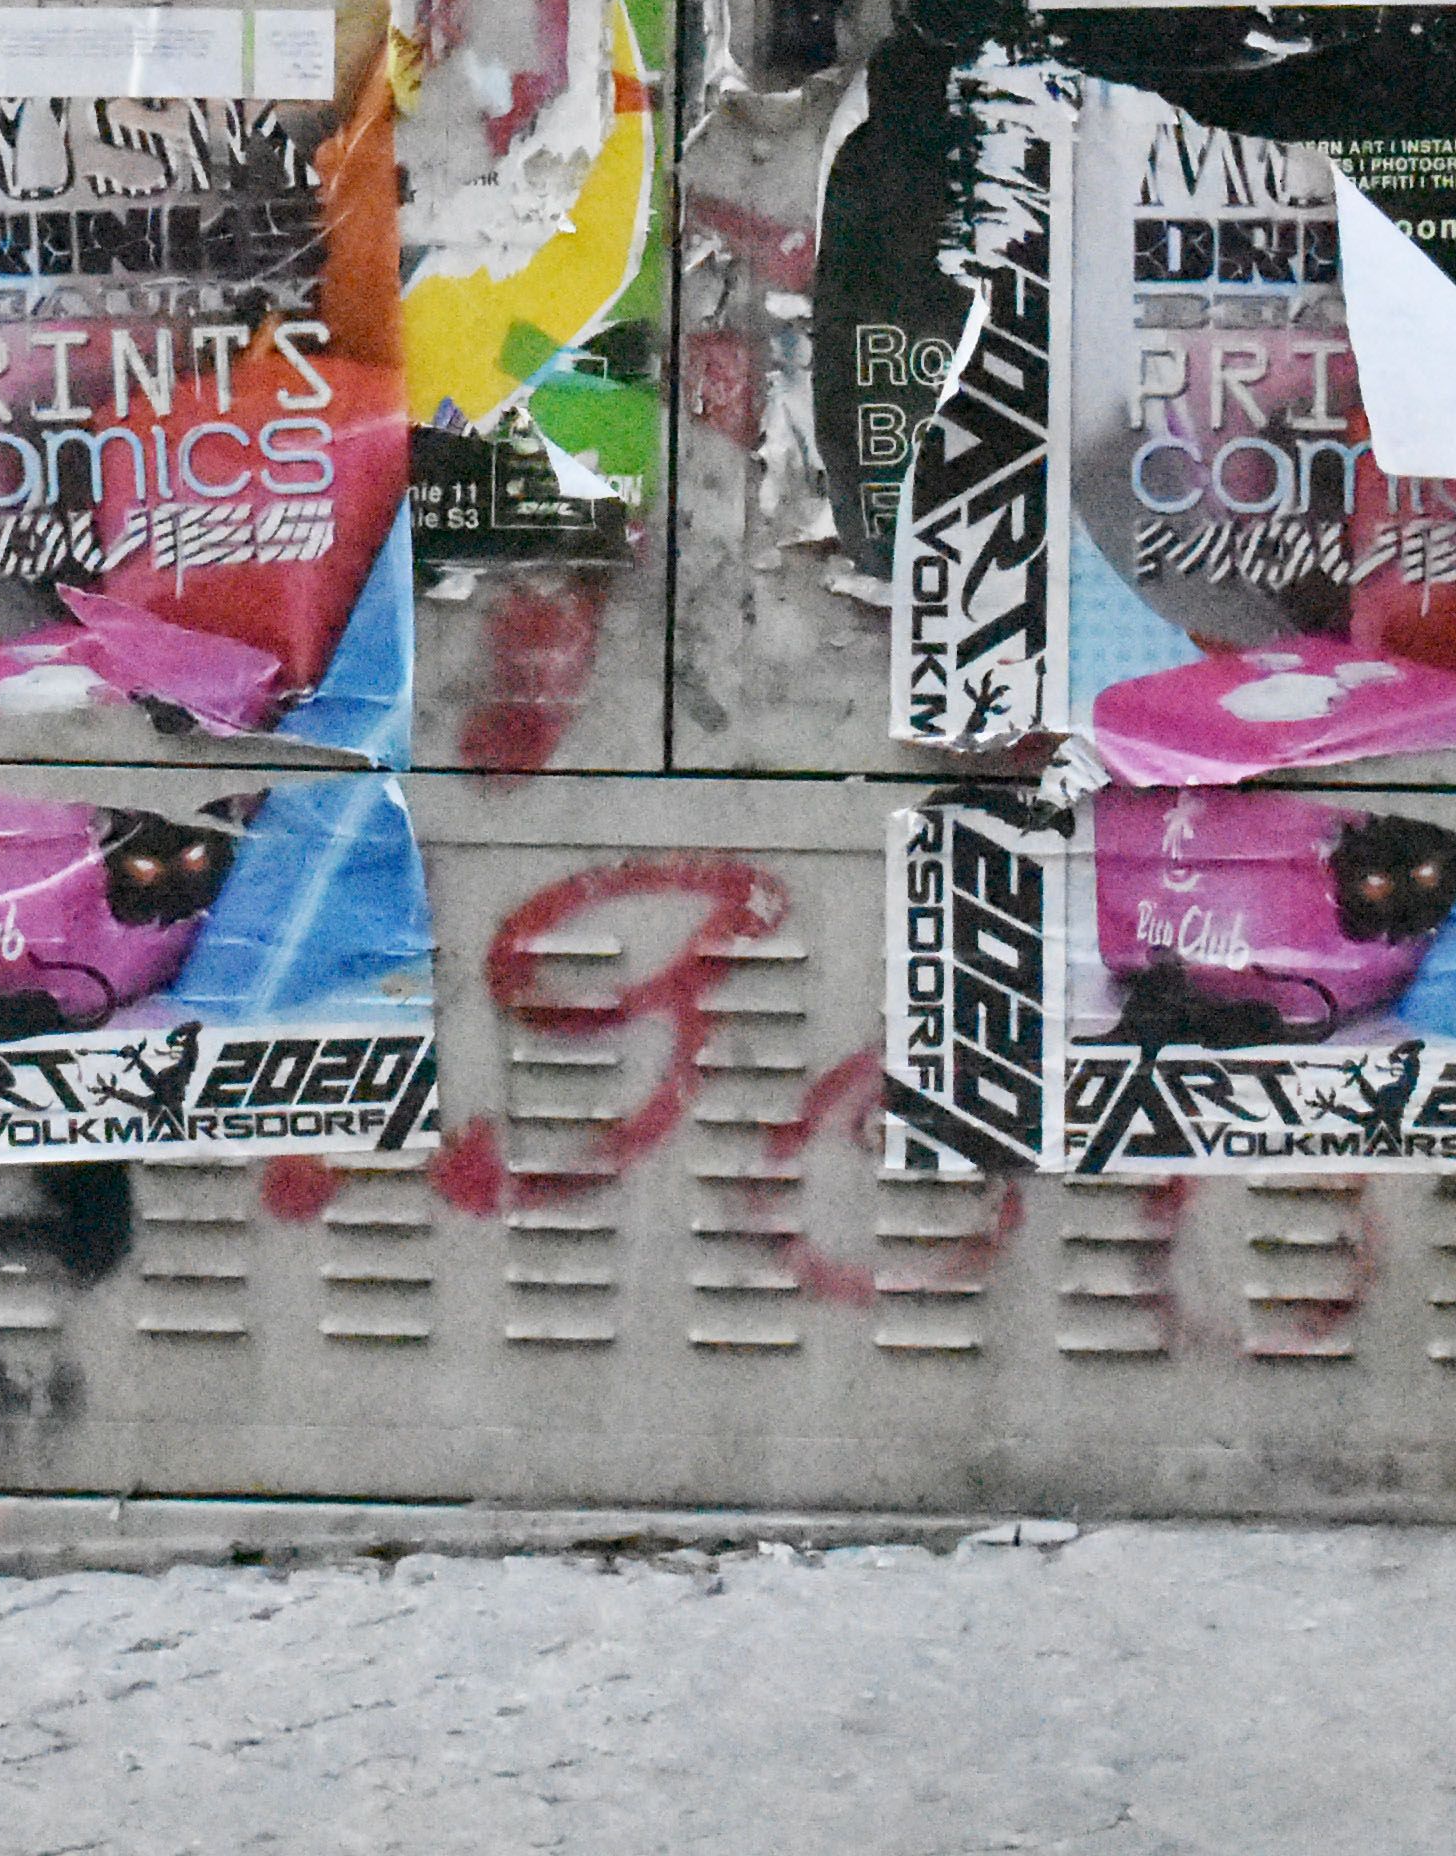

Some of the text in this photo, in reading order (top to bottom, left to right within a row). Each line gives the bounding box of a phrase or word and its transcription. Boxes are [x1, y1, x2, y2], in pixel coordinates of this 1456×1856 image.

[1349, 141, 1384, 153] ART
[452, 481, 478, 504] 11
[447, 507, 480, 529] S3
[196, 1036, 425, 1109] 2020
